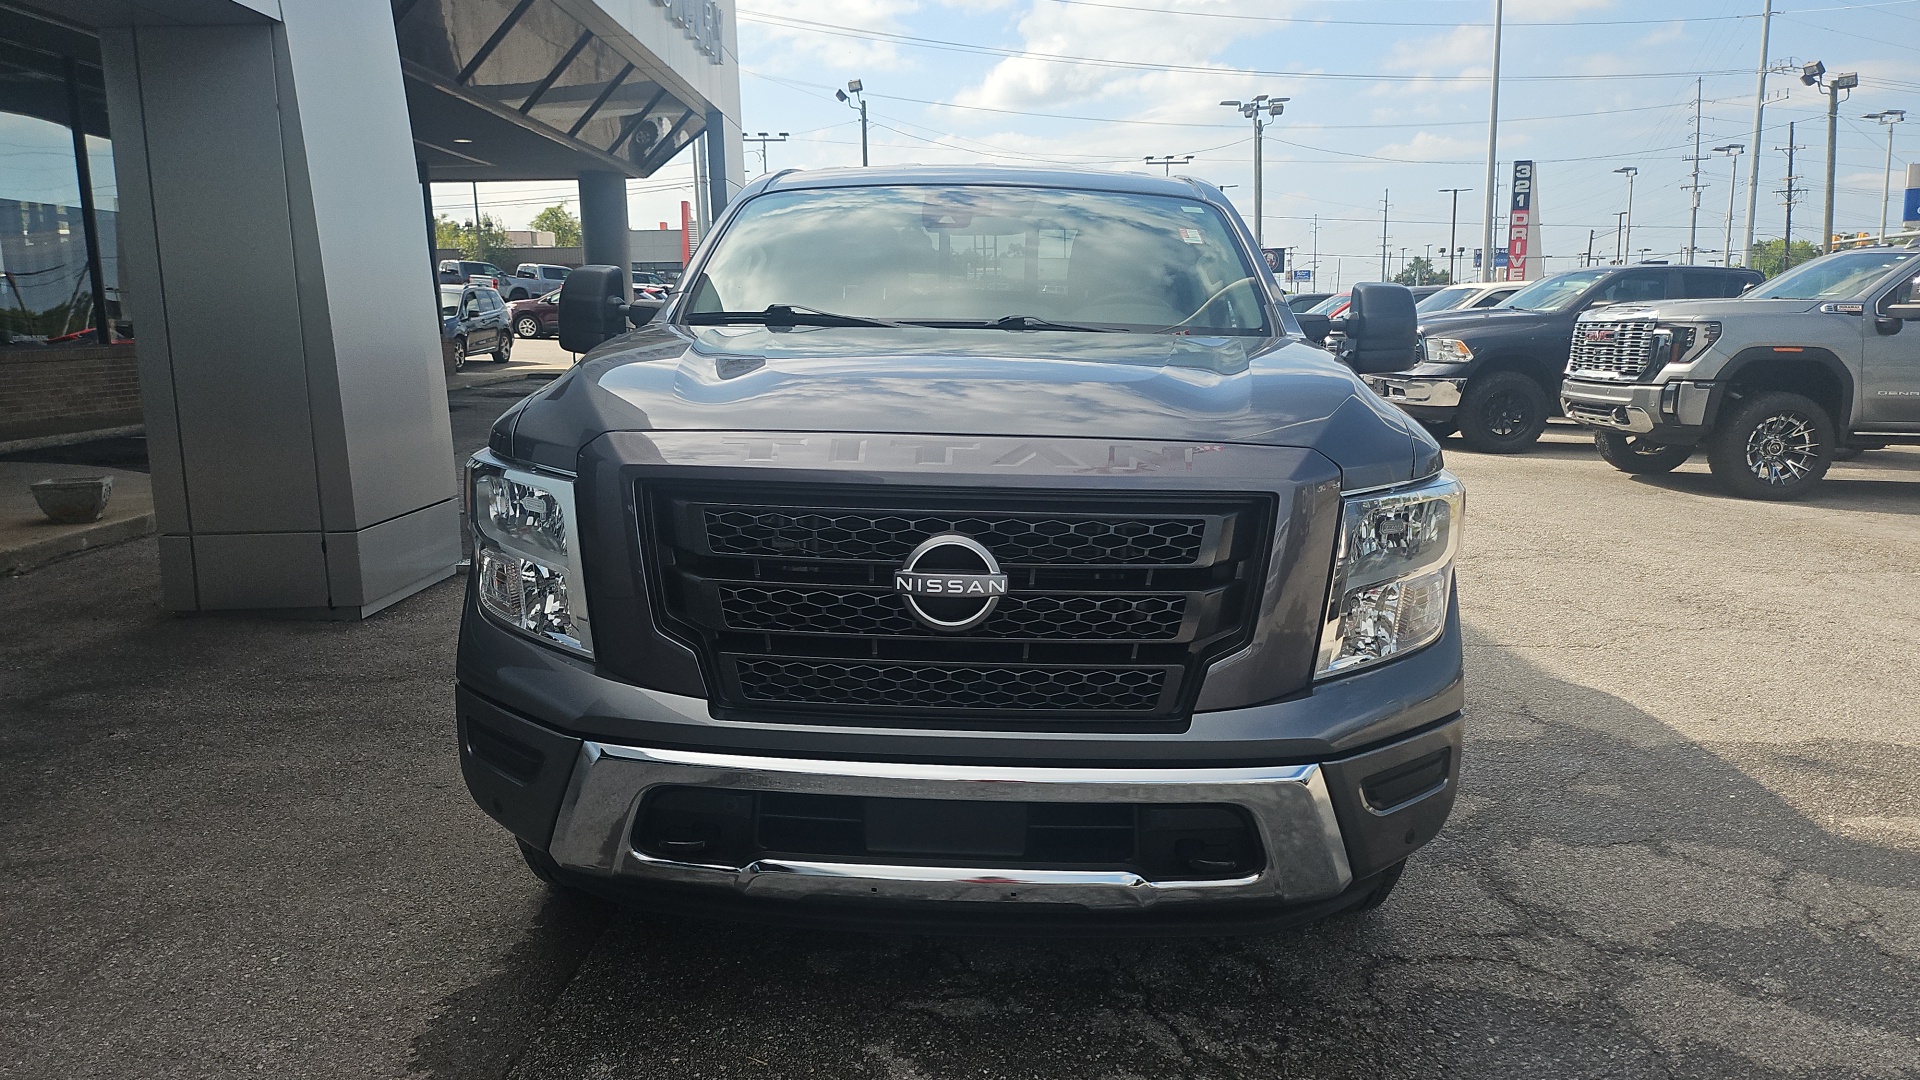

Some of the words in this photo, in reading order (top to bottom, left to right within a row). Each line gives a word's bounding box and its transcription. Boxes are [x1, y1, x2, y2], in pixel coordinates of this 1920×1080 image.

[1514, 165, 1531, 207] 321
[1509, 213, 1528, 280] DRIVE
[720, 437, 1194, 471] TITAN
[896, 576, 1005, 594] NISSAN
